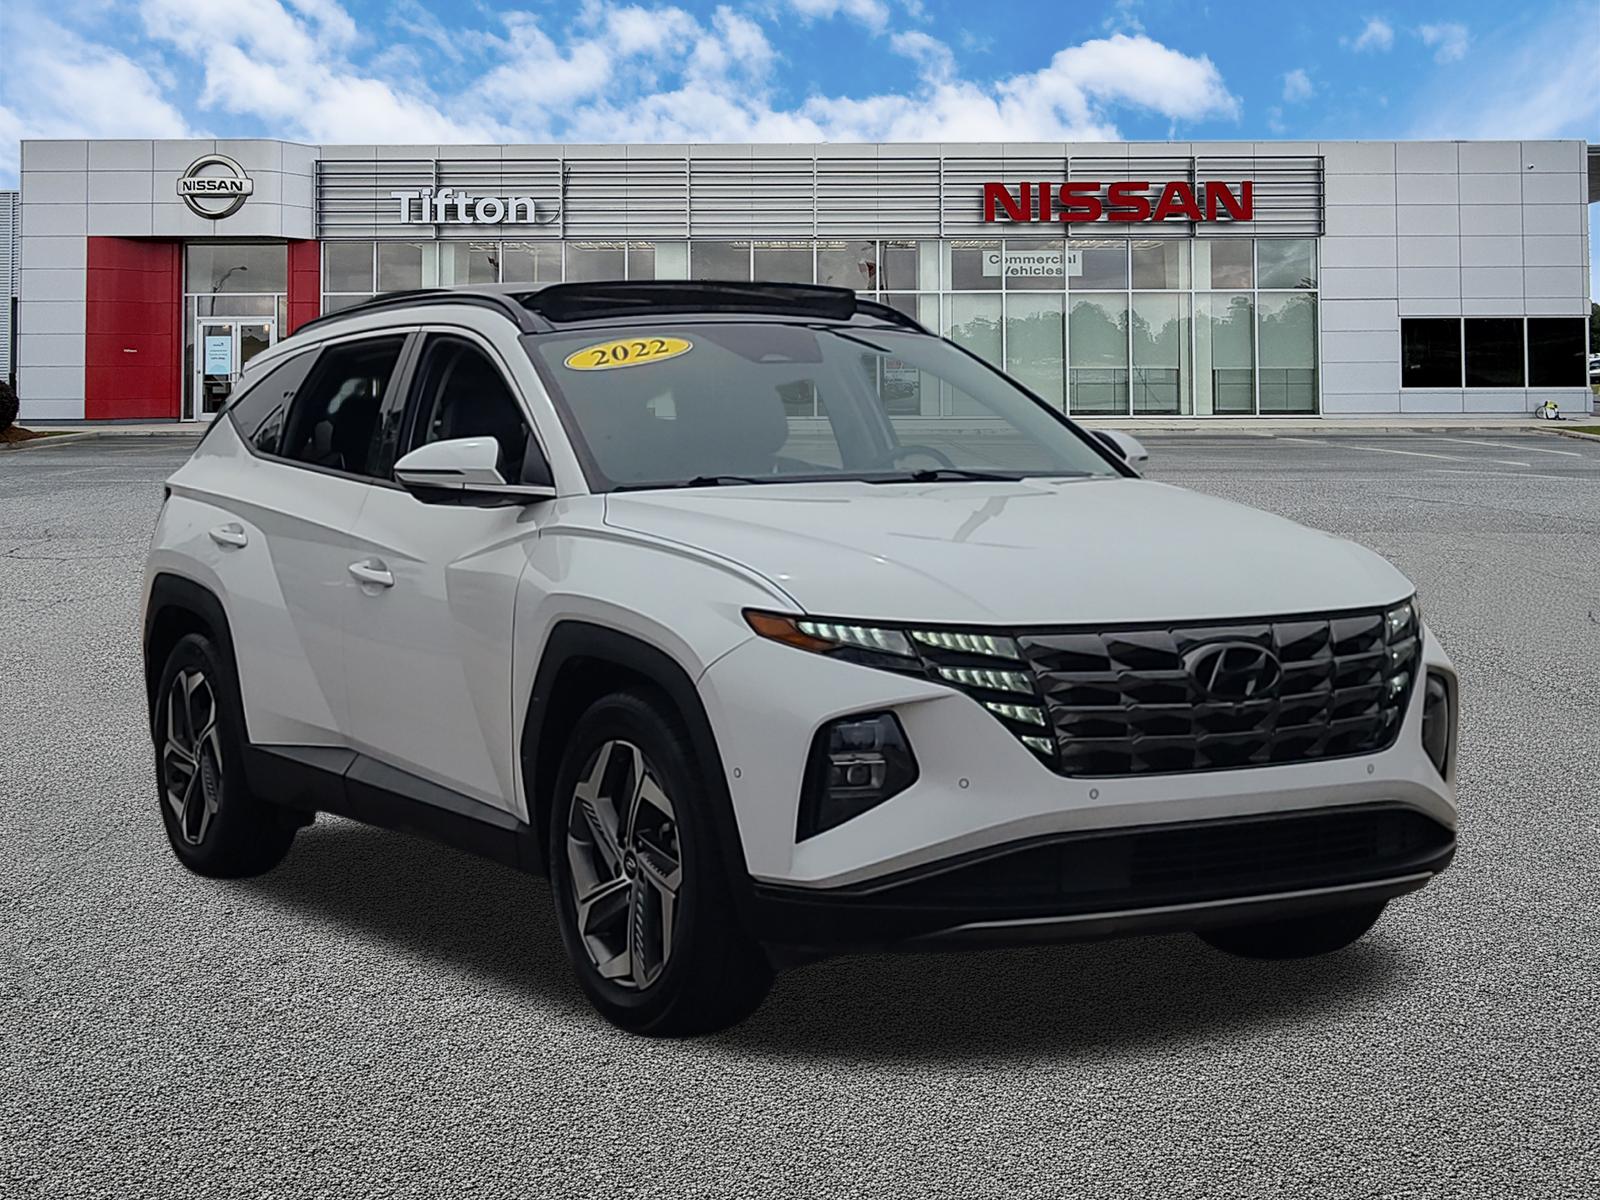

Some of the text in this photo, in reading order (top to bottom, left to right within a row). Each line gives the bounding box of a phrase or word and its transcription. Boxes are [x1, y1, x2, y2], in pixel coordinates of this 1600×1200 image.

[182, 180, 243, 191] NISSAN
[391, 188, 535, 224] Tifton
[983, 181, 1254, 222] NISSAN
[590, 339, 669, 366] 2022
